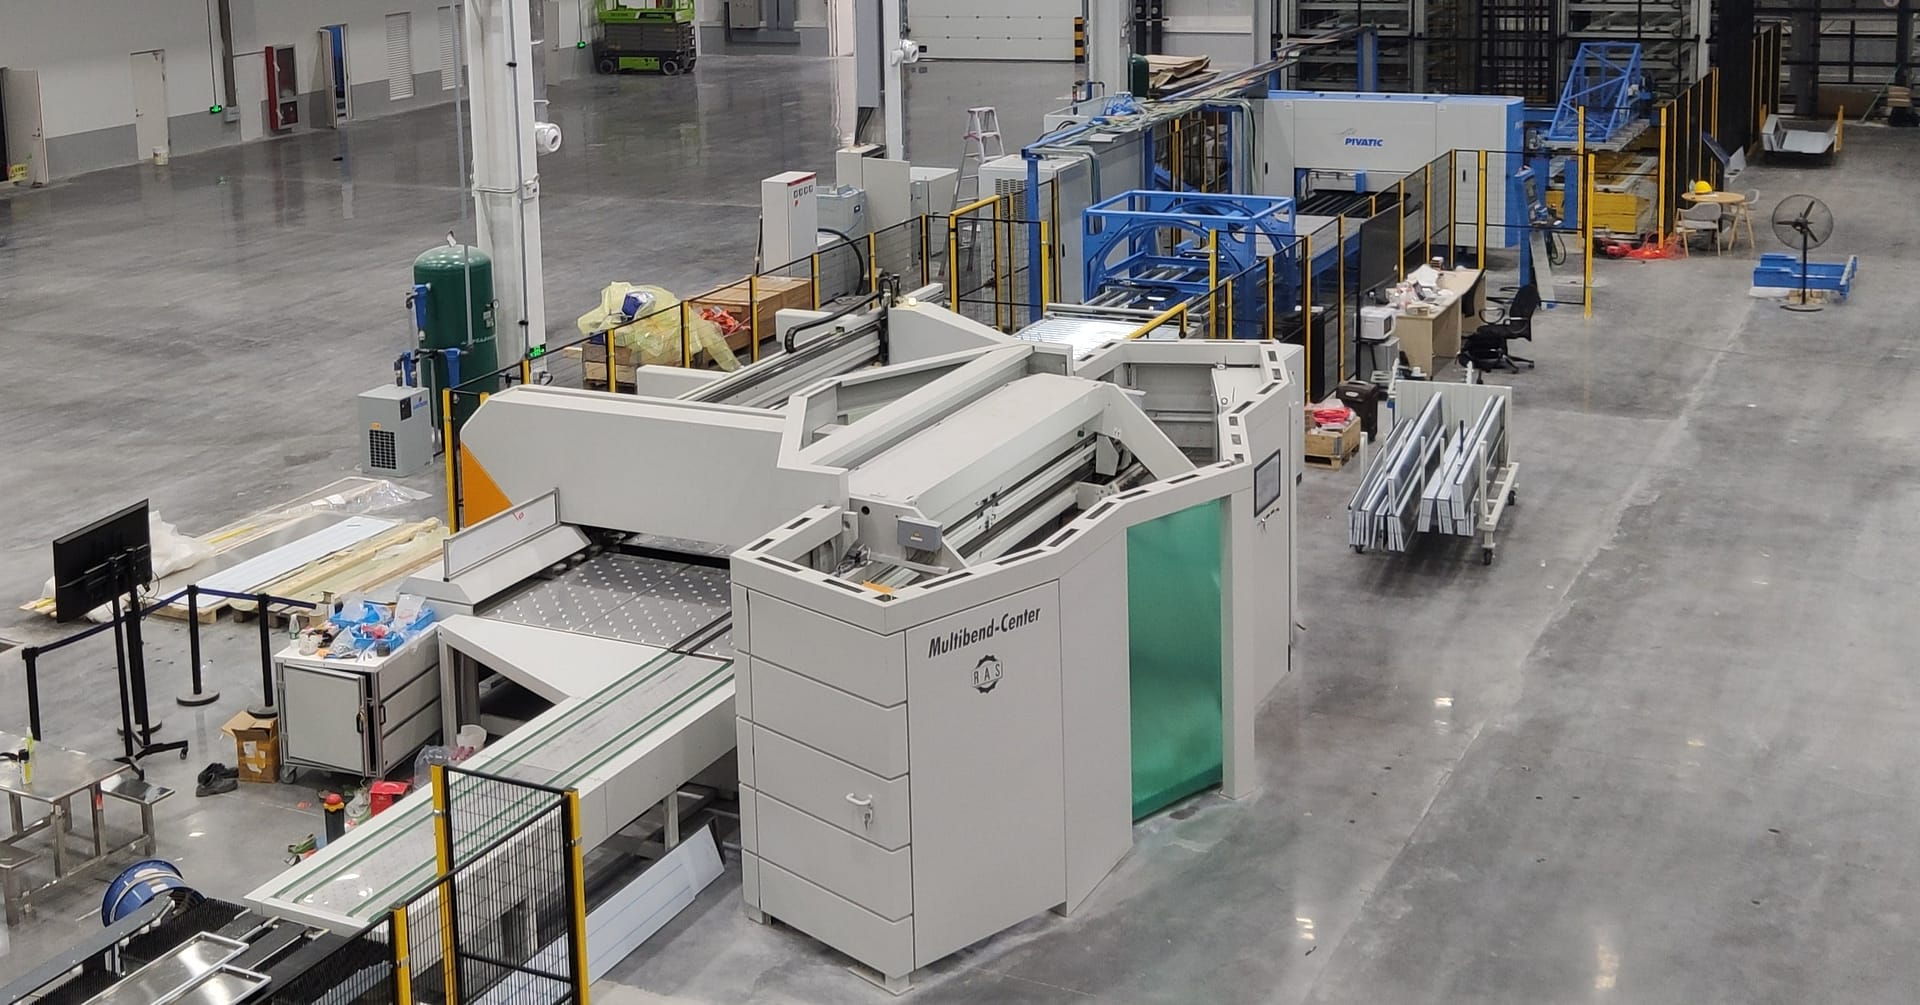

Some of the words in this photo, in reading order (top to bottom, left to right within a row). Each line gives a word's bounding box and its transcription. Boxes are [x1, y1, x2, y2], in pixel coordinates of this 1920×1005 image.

[1344, 137, 1383, 147] PIVATIC
[928, 607, 1041, 658] Multibend-Center
[973, 663, 1001, 685] RAS
